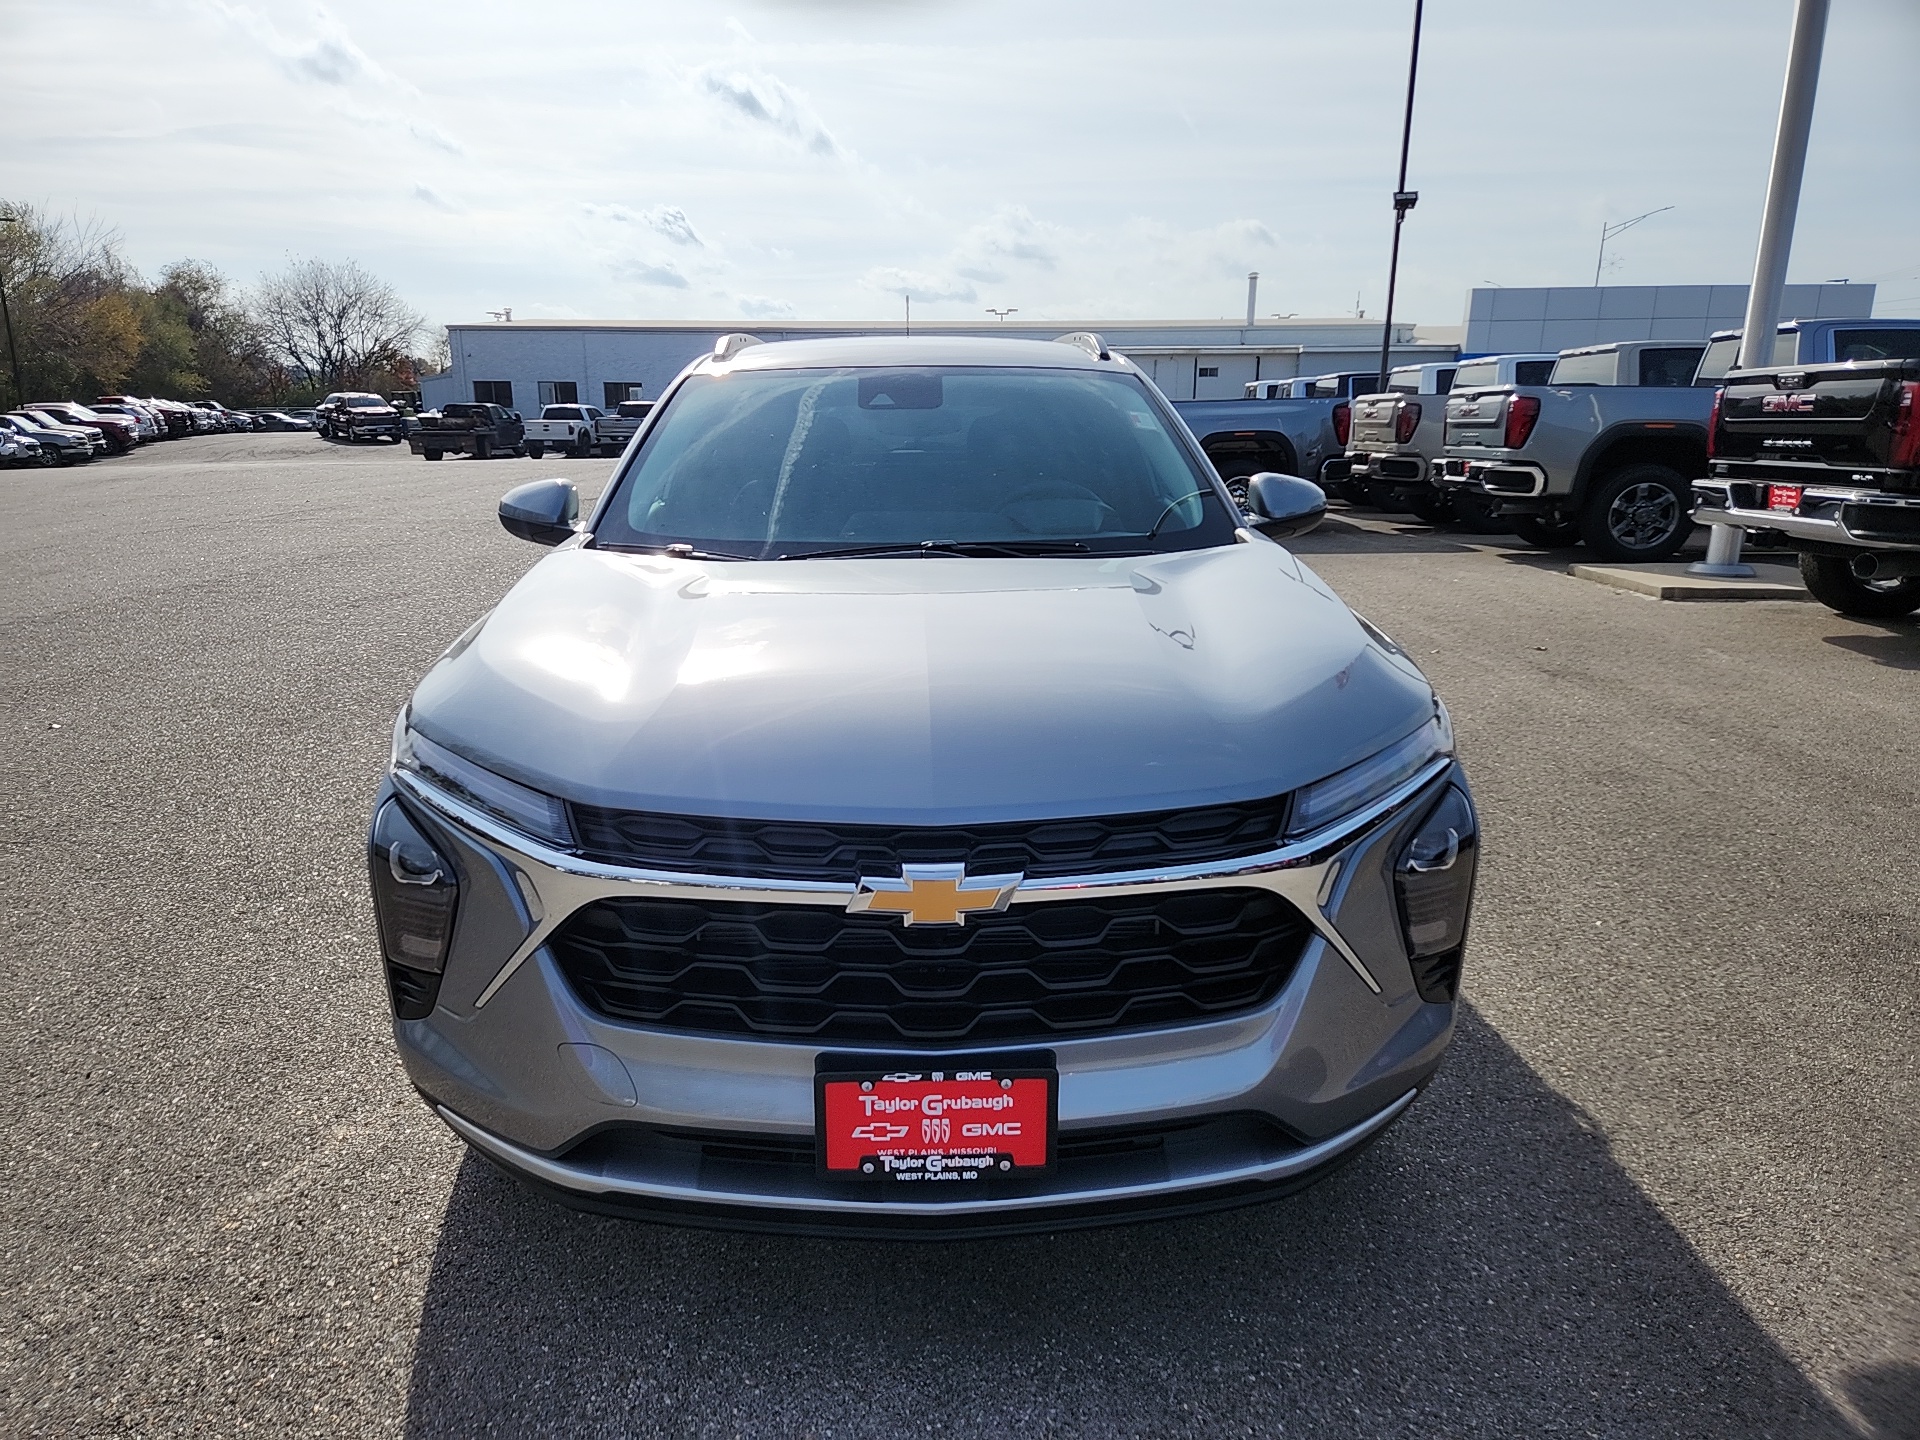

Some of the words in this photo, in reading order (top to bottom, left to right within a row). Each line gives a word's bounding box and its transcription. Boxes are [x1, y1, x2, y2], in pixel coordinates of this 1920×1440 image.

[1762, 394, 1817, 412] GMC
[955, 1071, 992, 1081] GMC
[858, 1095, 919, 1117] Taylor
[921, 1094, 1013, 1116] Grubaugh
[961, 1122, 1022, 1137] GMC
[876, 1148, 906, 1156] WEST
[949, 1147, 997, 1155] MISSOURI
[880, 1156, 924, 1173] Taylor
[925, 1155, 994, 1172] Grubaugh
[896, 1172, 923, 1181] WEST
[924, 1171, 961, 1181] PLAINS,
[962, 1170, 978, 1180] MO
